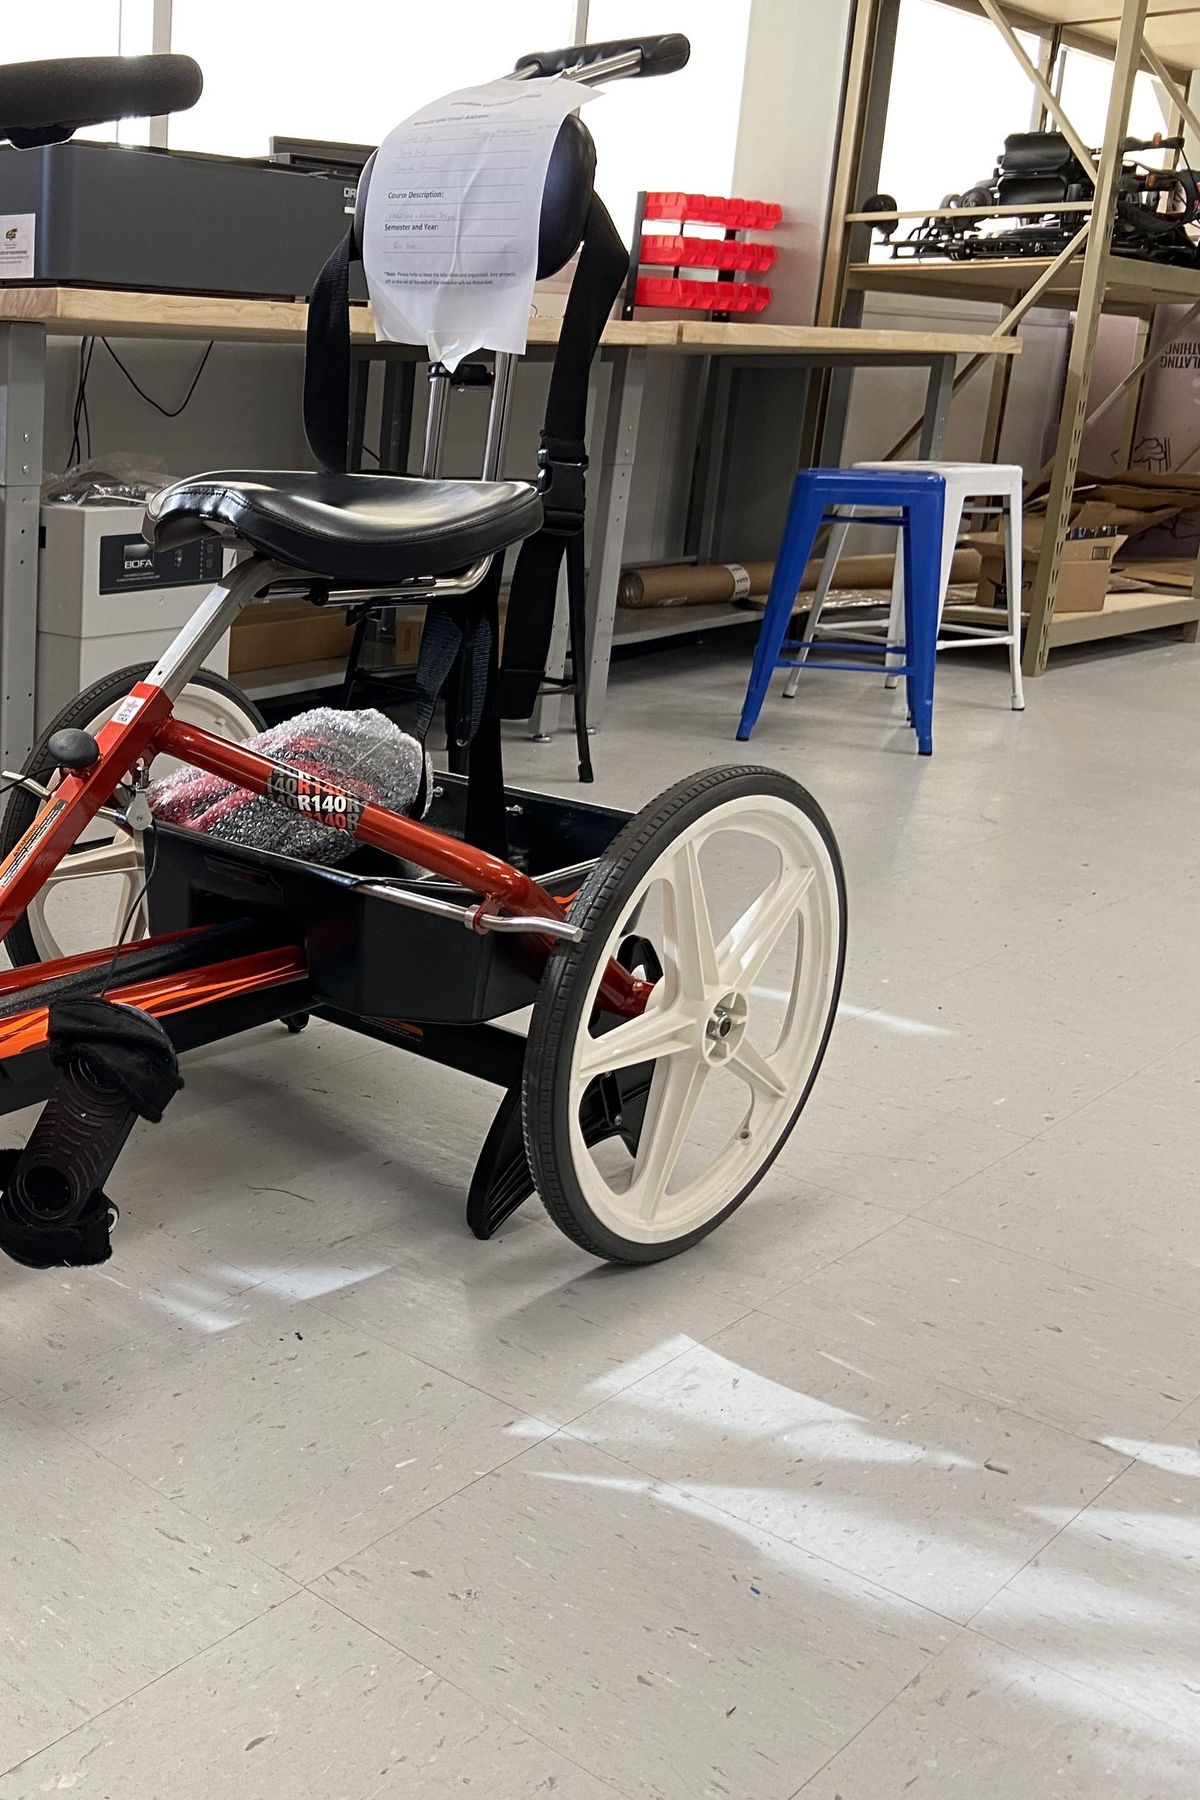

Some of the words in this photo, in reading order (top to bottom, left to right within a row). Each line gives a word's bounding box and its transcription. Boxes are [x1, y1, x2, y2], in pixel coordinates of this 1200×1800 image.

[387, 191, 408, 199] Course
[408, 191, 444, 199] Description:
[384, 223, 411, 231] Semester
[411, 223, 423, 231] and
[423, 223, 439, 231] Year:
[124, 559, 153, 570] BOFA
[298, 794, 347, 813] R140
